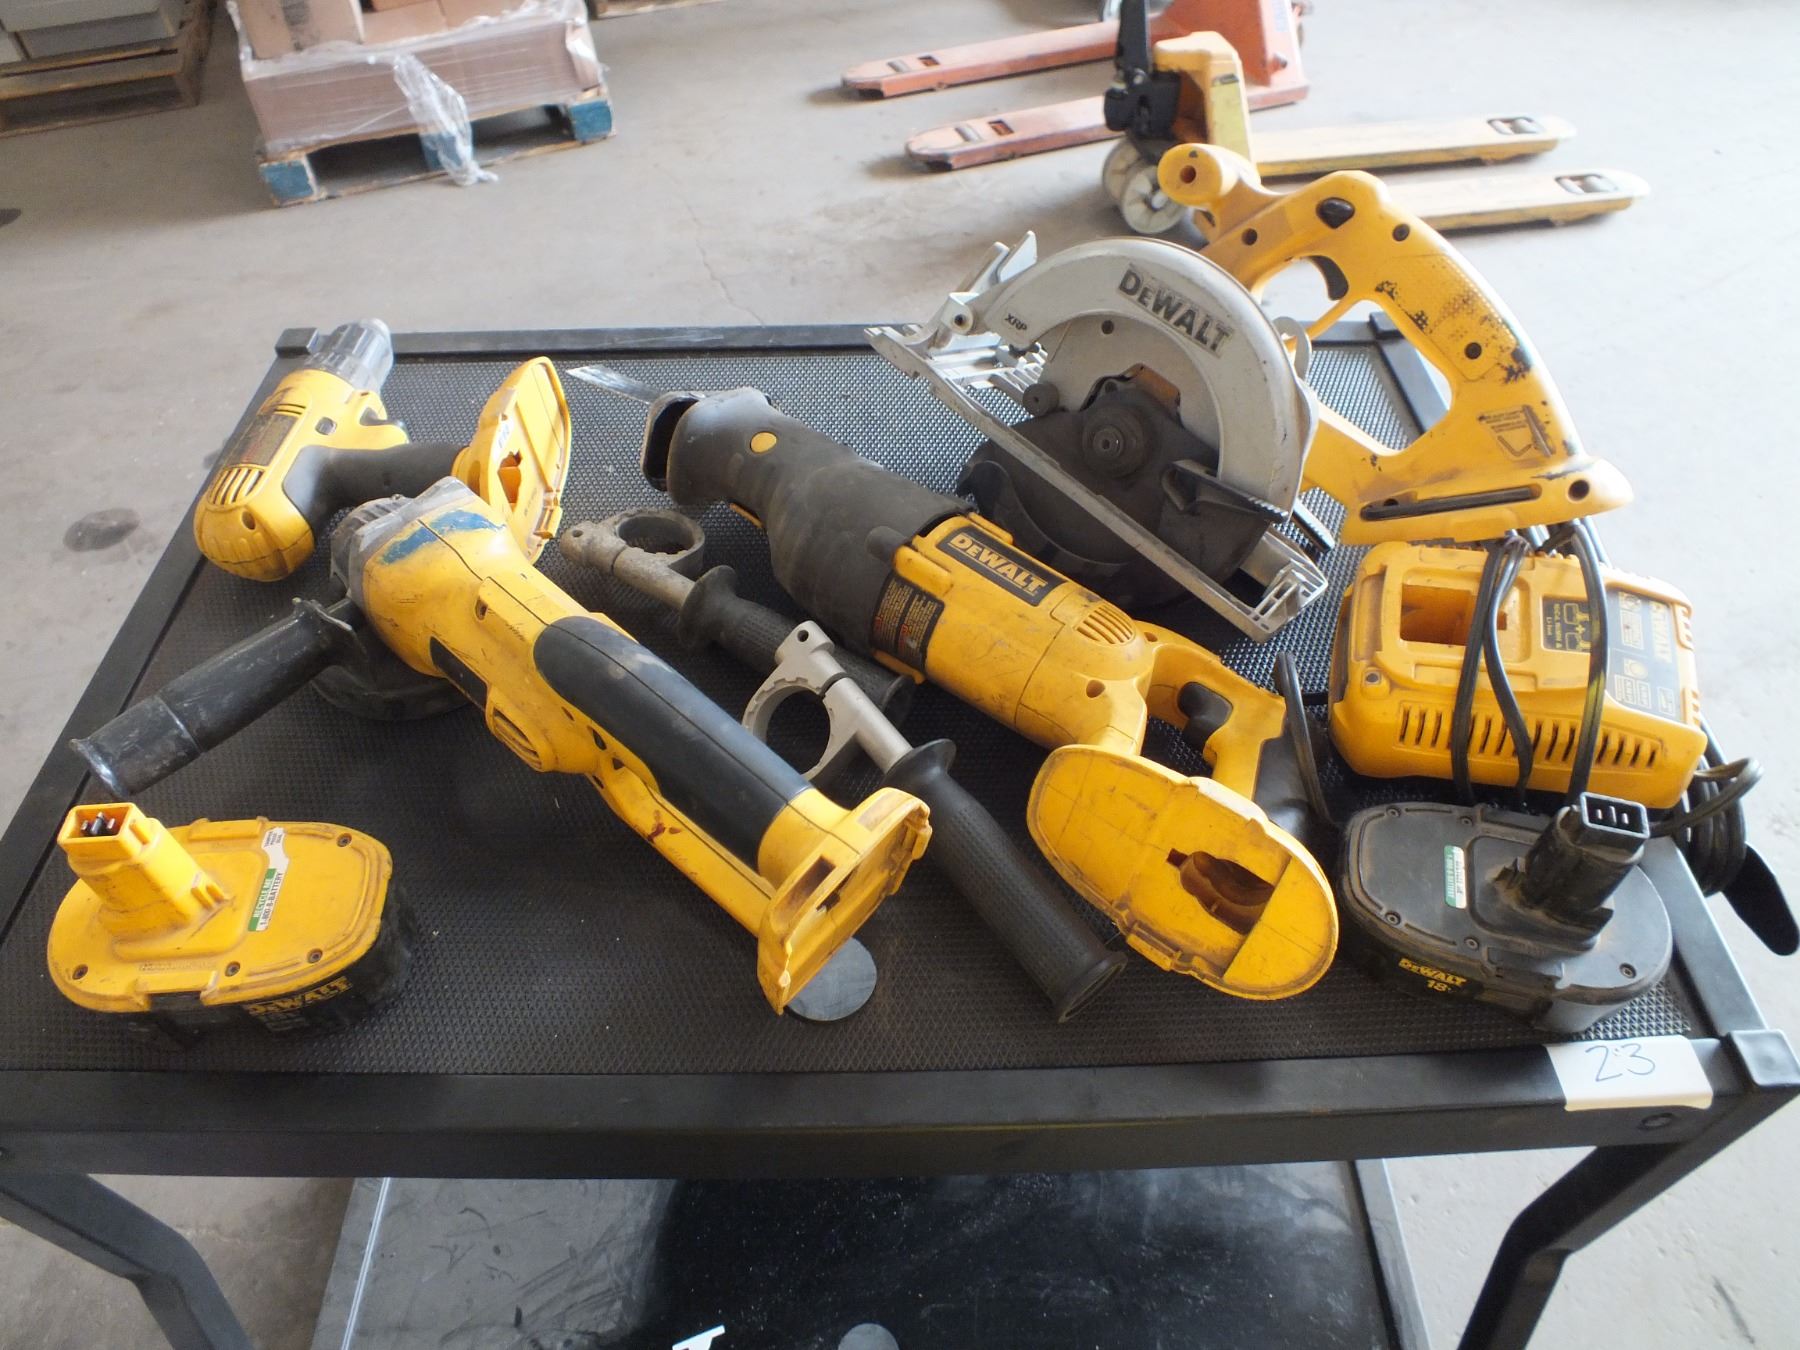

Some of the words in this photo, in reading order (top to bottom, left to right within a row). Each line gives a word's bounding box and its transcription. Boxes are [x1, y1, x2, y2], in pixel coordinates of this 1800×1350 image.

[1004, 312, 1028, 331] XRP
[1118, 269, 1231, 352] DEWALT
[950, 531, 1048, 595] DEWALT
